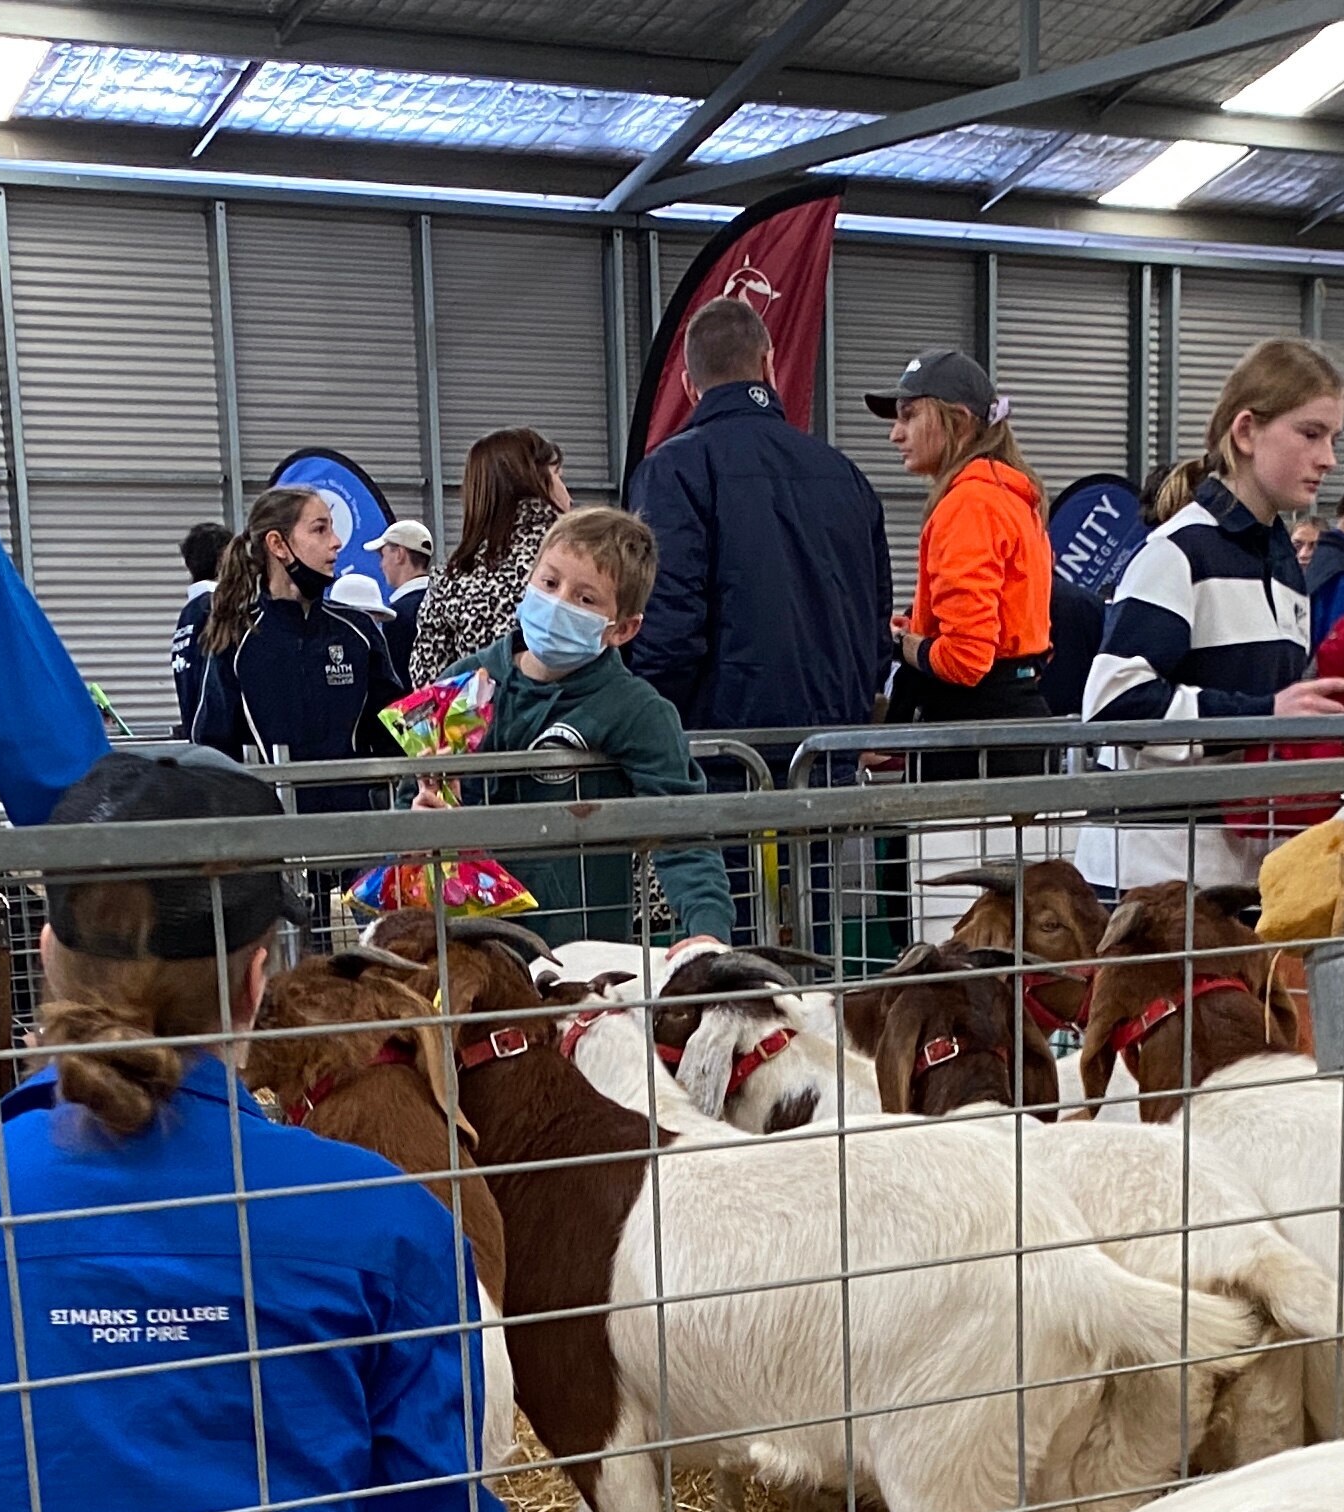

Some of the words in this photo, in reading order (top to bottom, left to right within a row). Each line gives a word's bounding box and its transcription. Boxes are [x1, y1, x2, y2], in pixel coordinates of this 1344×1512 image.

[1077, 535, 1120, 588] LLEGE
[146, 1306, 230, 1323] COLLEGE
[91, 1326, 143, 1344] PORT
[145, 1325, 191, 1343] PIRIE
